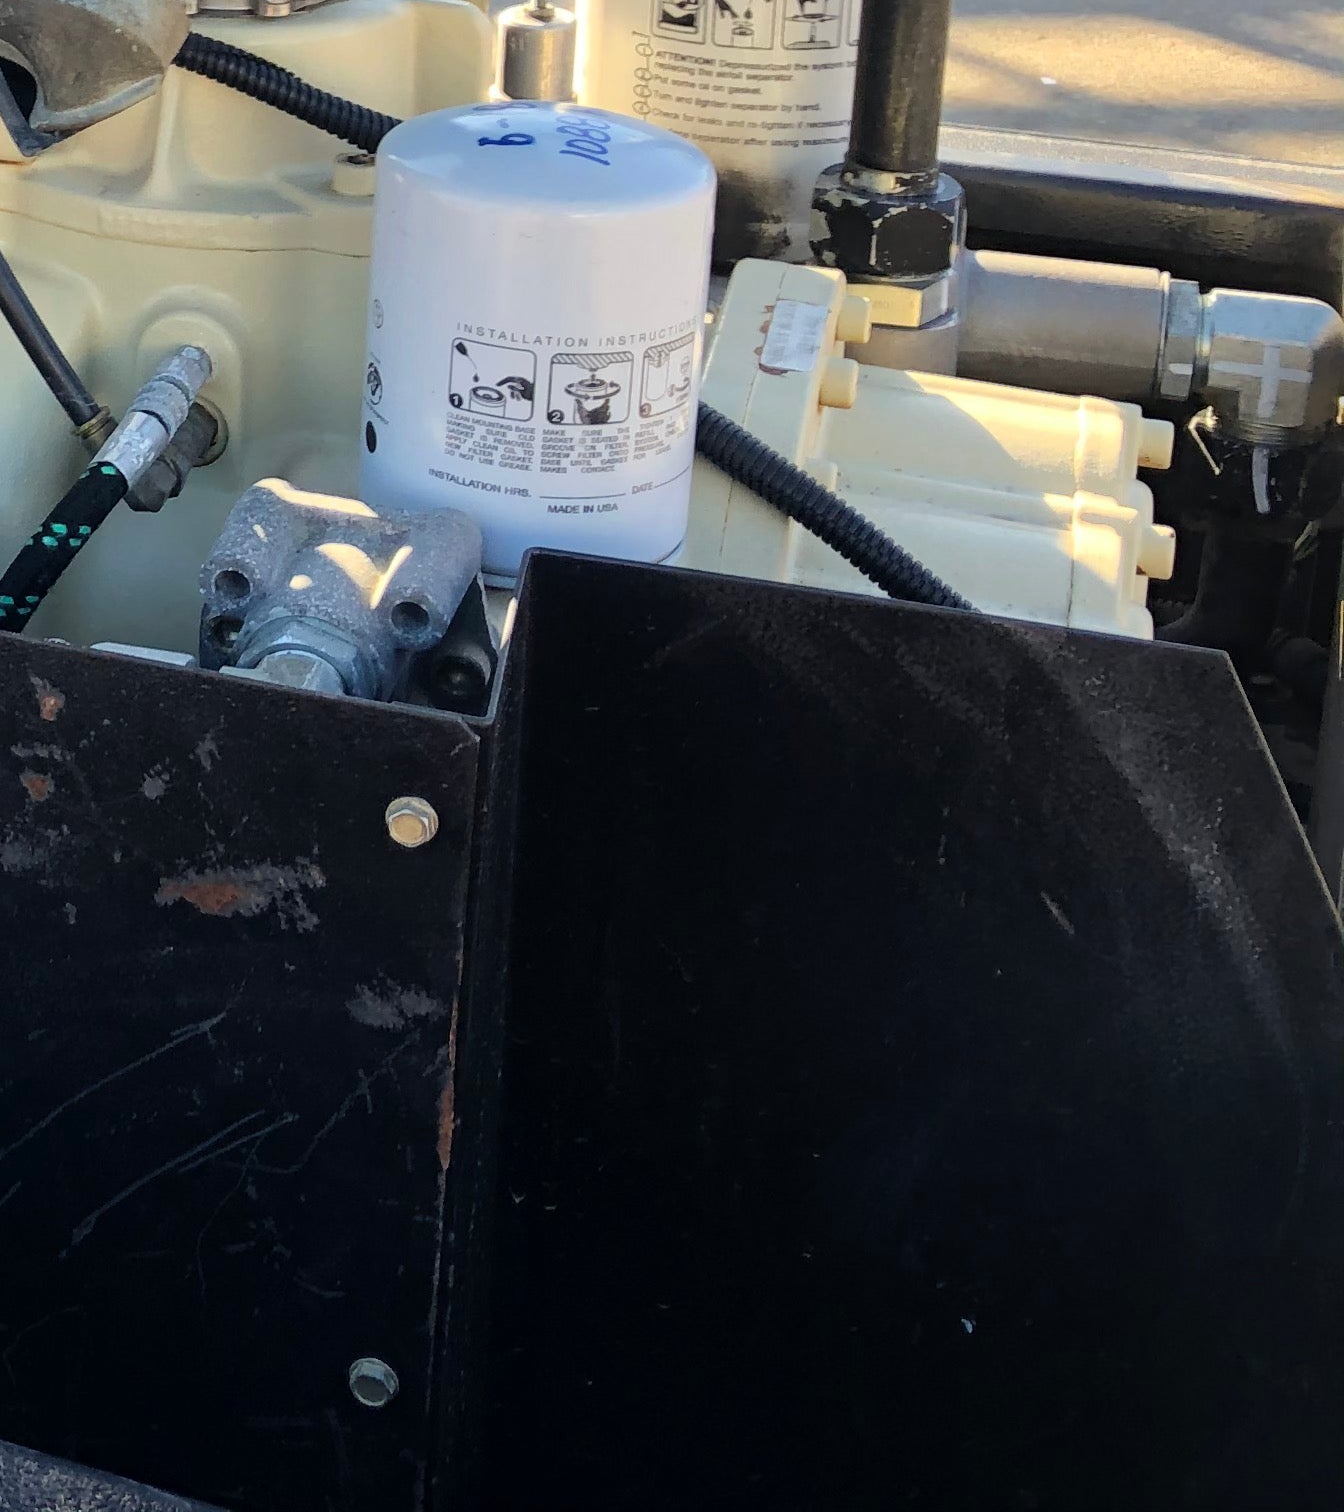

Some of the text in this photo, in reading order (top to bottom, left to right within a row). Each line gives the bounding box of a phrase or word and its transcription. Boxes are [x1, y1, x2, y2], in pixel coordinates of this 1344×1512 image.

[456, 315, 698, 348] INSTALLATION INSTRUCTIONS
[428, 468, 502, 495] INSTALLATION
[631, 482, 655, 494] DATE
[547, 503, 619, 515] MADE IN USA
